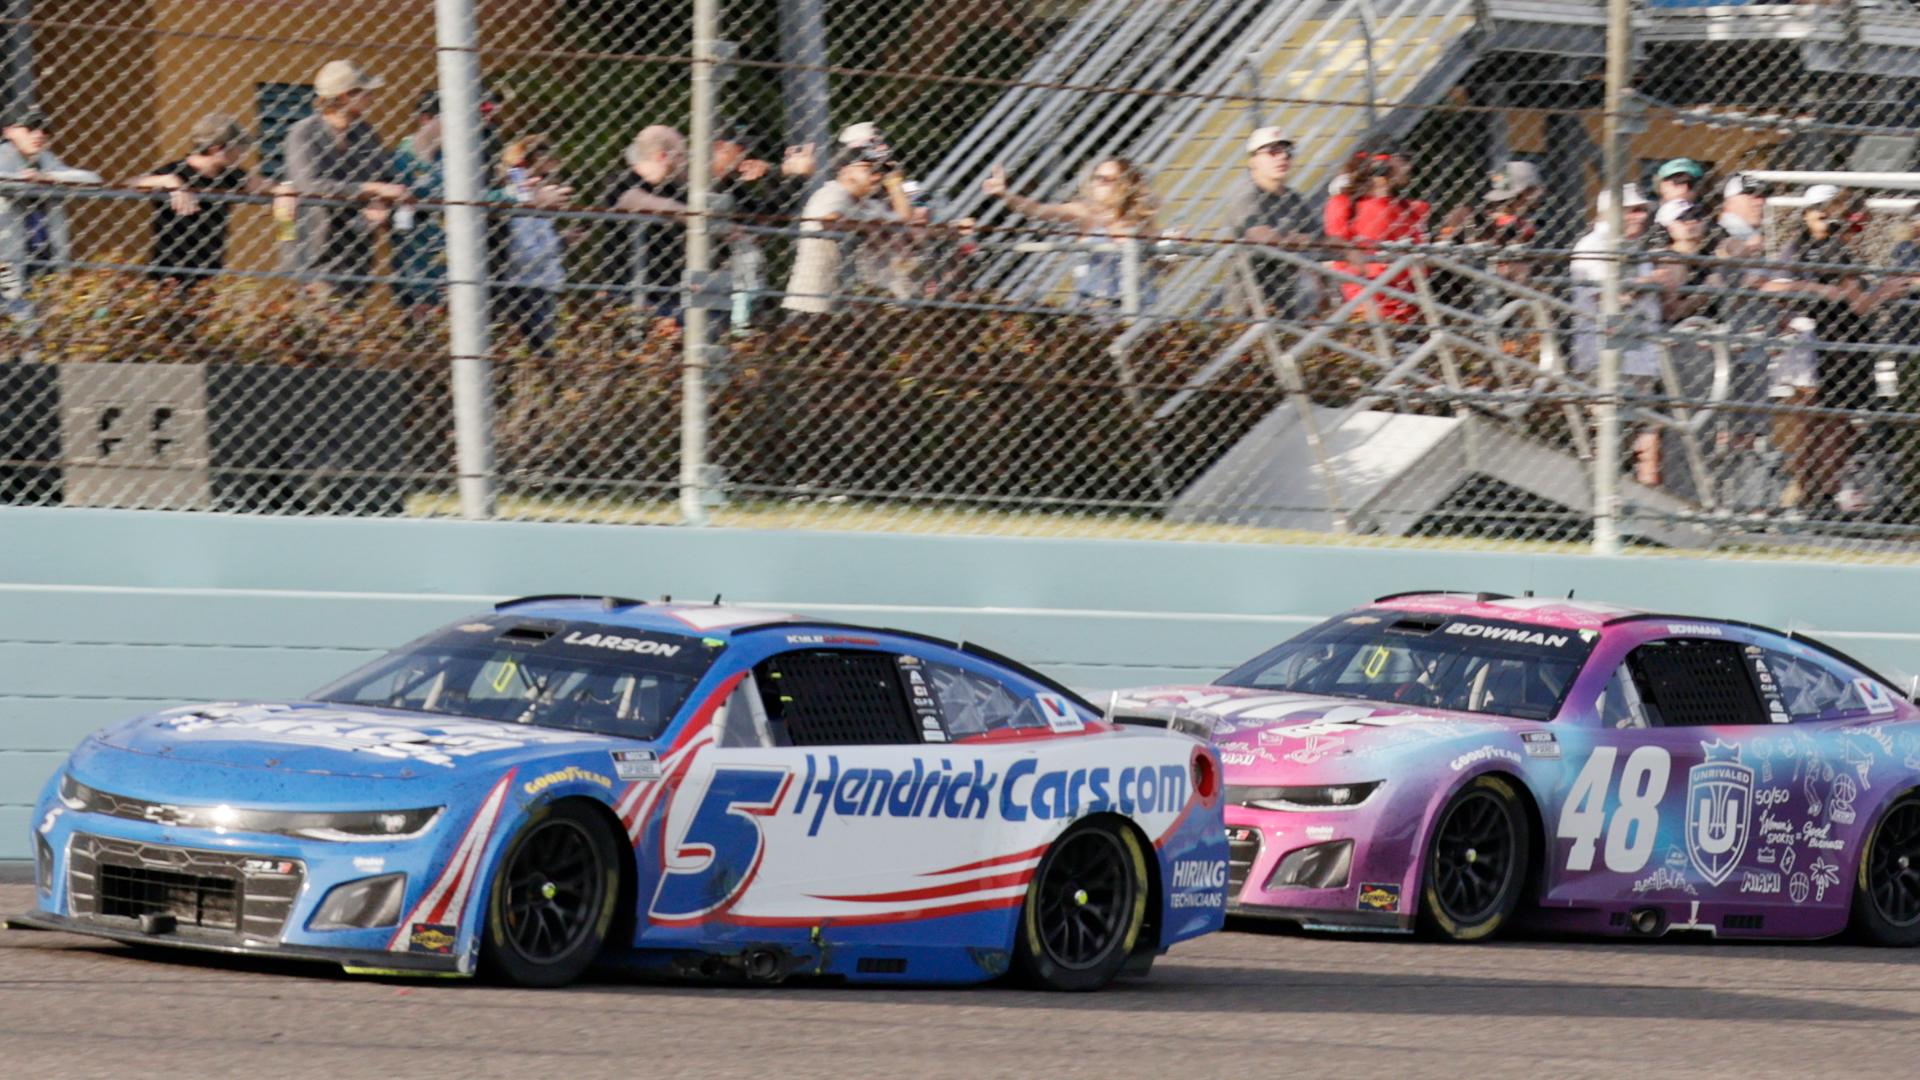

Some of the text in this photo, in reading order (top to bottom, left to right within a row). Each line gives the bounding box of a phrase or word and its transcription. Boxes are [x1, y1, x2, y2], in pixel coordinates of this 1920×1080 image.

[563, 631, 681, 657] LARSON
[1445, 622, 1569, 648] BOWMAN
[1450, 745, 1522, 771] GOODYEAR
[524, 766, 612, 794] GOODYEAR
[1693, 768, 1749, 783] UNRIVALED
[1556, 745, 1671, 873] 48
[1755, 786, 1790, 810] 50/50
[648, 765, 793, 921] 5
[1172, 860, 1226, 888] HIRING
[1741, 870, 1781, 893] MIAMI
[1170, 892, 1223, 909] TECHNICIANS
